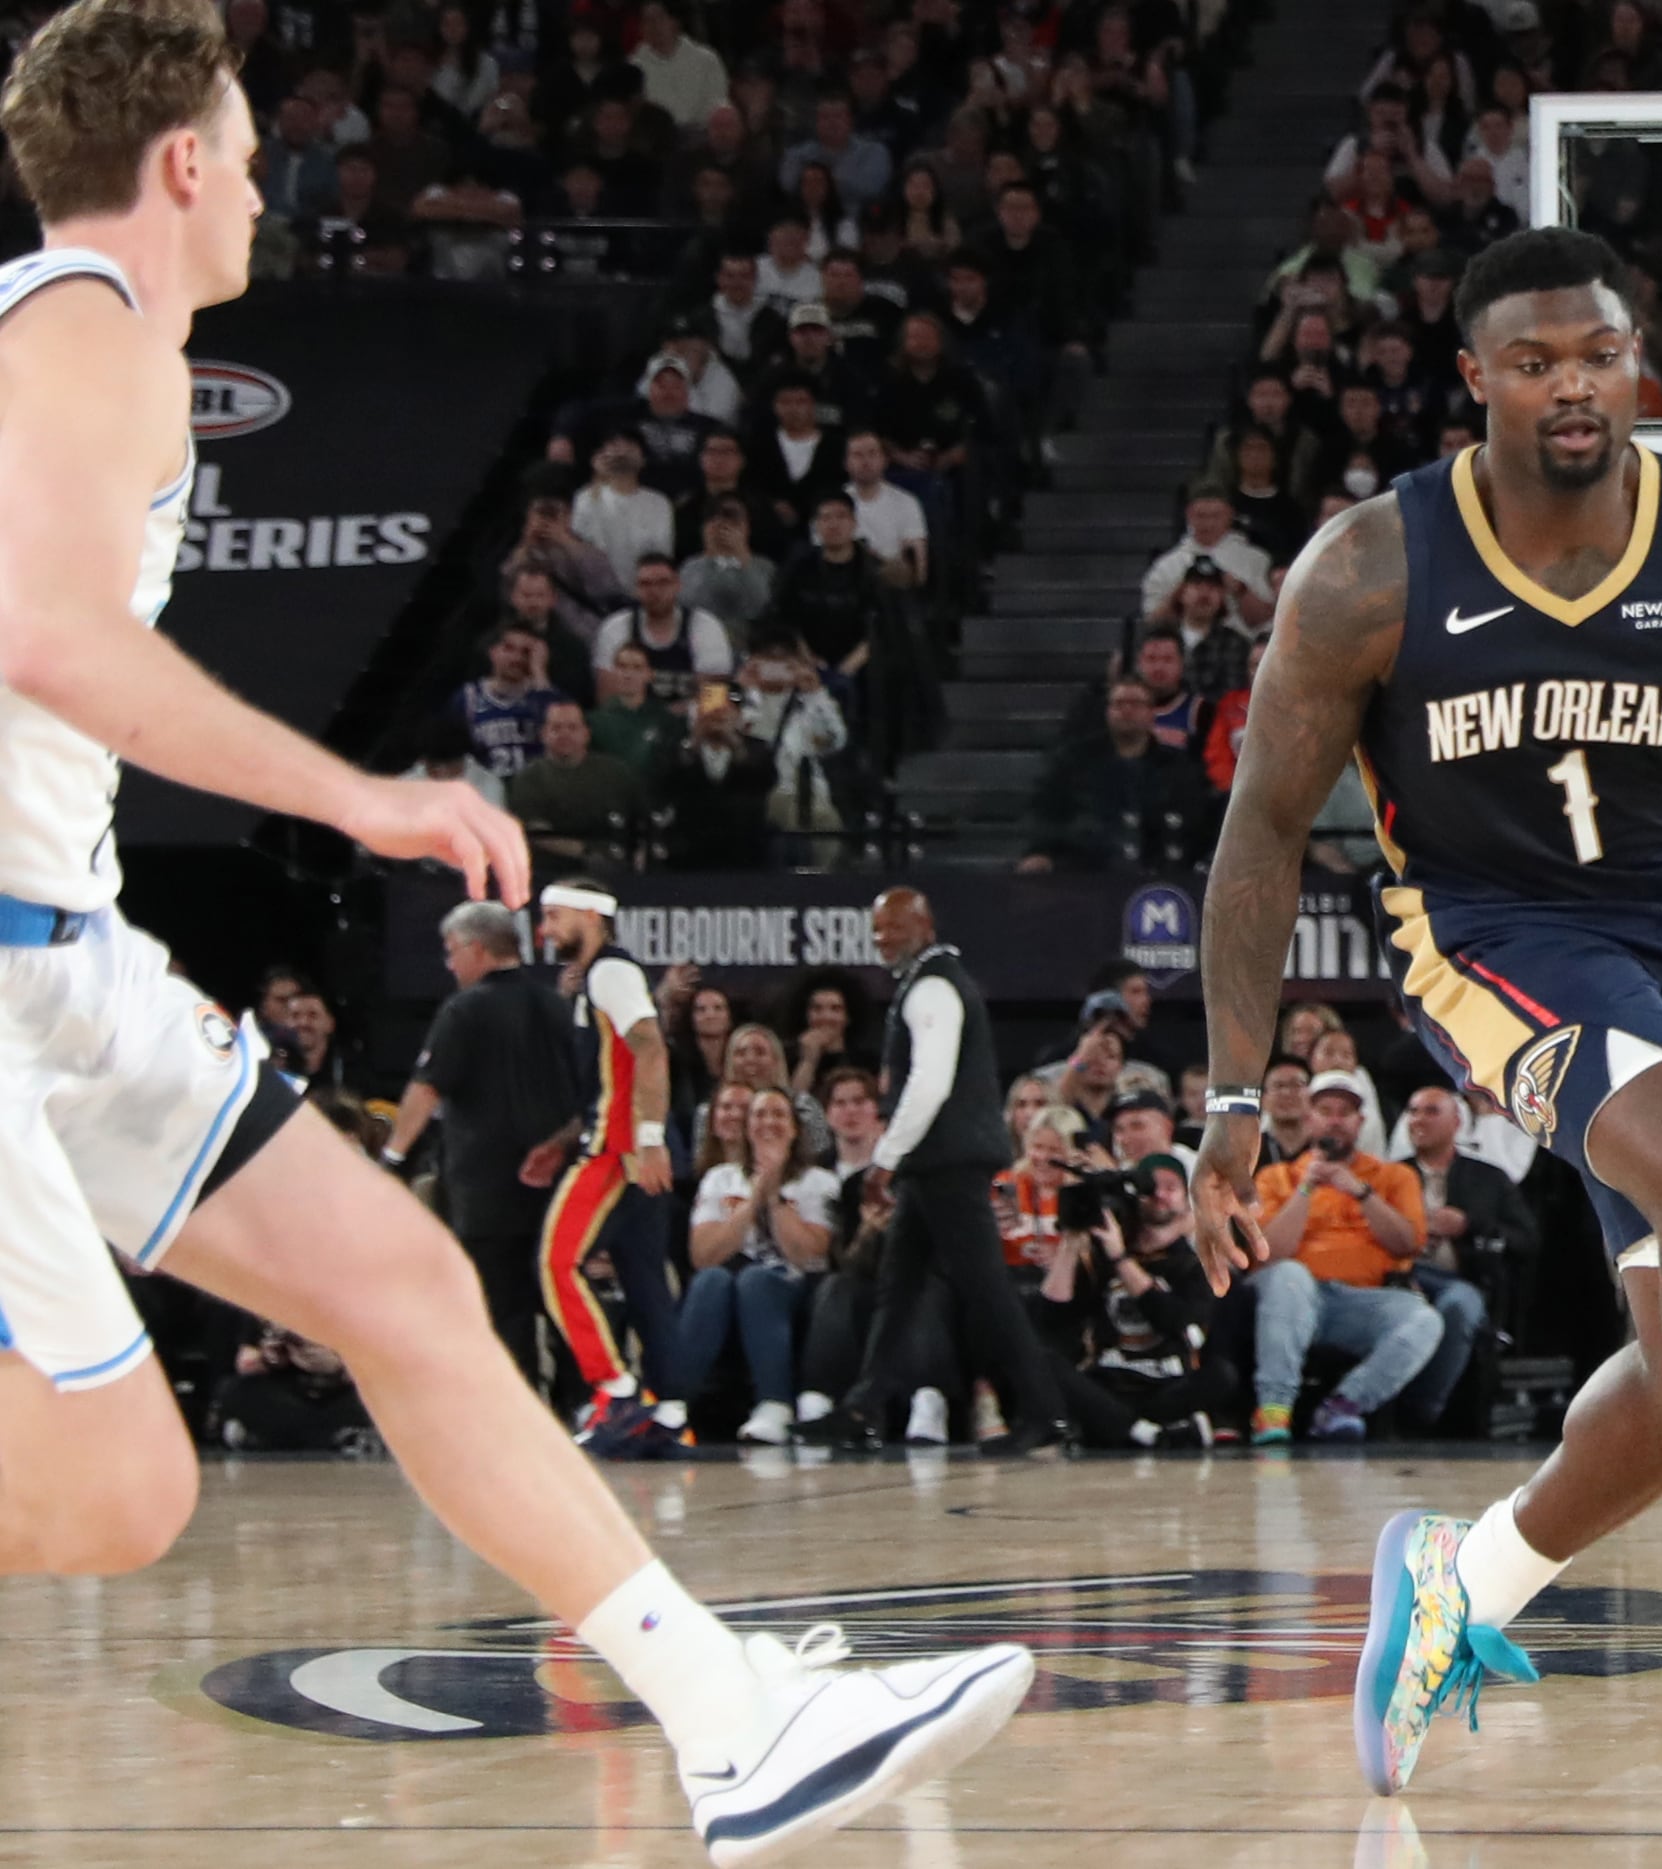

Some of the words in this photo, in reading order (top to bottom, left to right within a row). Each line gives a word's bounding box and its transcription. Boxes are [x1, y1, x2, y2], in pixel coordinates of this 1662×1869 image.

[193, 388, 240, 416] BL
[172, 512, 431, 572] SERIES
[1426, 683, 1525, 762] NEW
[1547, 749, 1603, 864] 1
[615, 906, 797, 966] MELBOURNE
[802, 906, 886, 966] SERI
[1141, 899, 1180, 936] M
